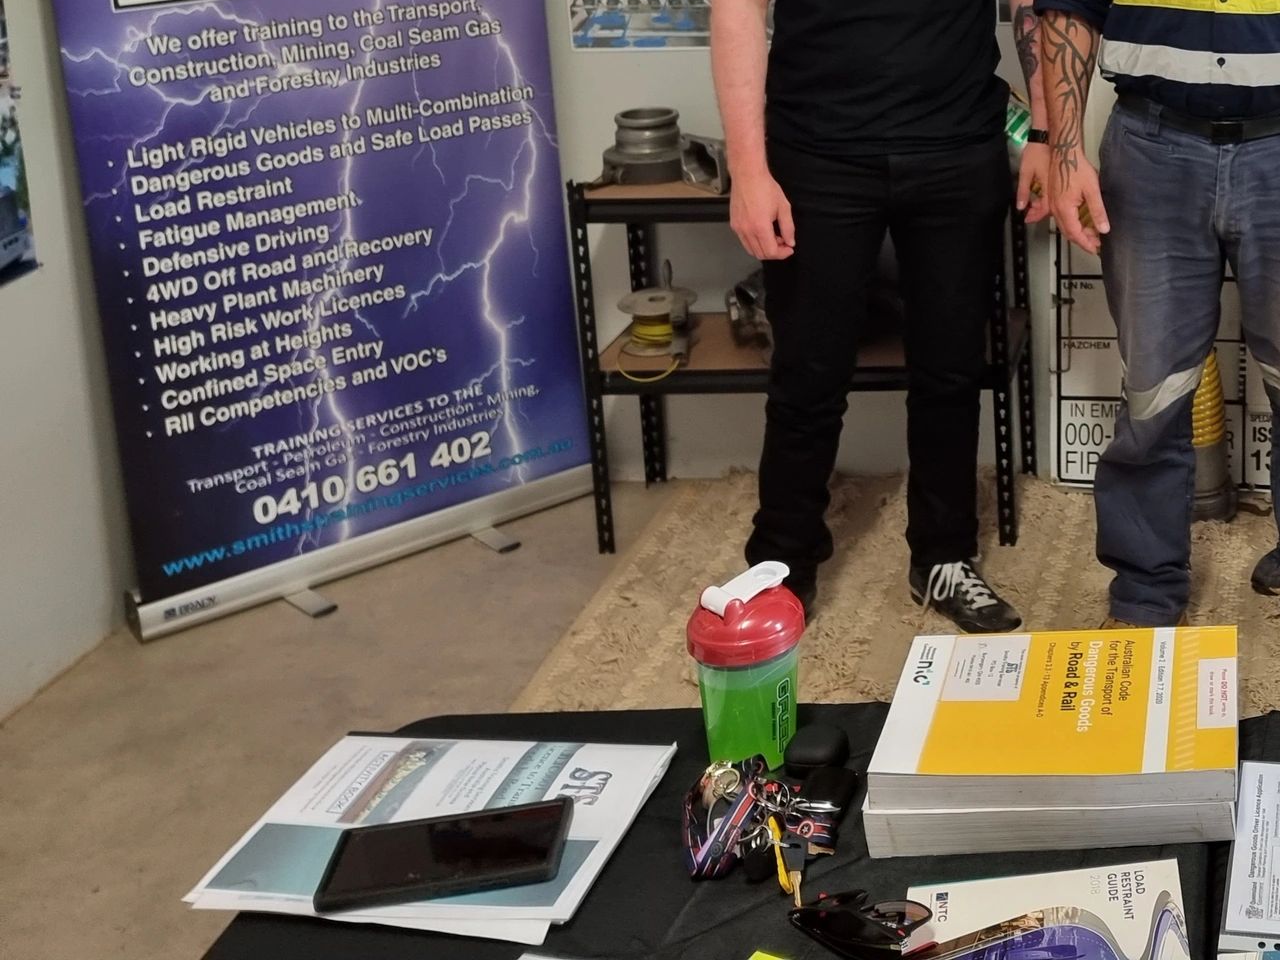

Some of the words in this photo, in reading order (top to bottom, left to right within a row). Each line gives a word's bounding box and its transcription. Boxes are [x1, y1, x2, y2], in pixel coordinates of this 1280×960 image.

[147, 36, 182, 55] We
[188, 29, 237, 52] offer
[243, 18, 323, 43] training
[328, 13, 349, 30] to
[353, 7, 384, 27] the
[128, 142, 186, 168] Light
[192, 133, 246, 159] Rigid
[251, 117, 336, 145] Vehicles
[342, 114, 361, 129] to
[366, 85, 533, 126] Multi-Combination
[135, 197, 190, 222] Load
[197, 179, 293, 210] Restraint
[150, 303, 217, 331] Heavy
[223, 286, 277, 313] Plant
[283, 264, 384, 301] Machinery
[252, 475, 347, 524] 0410
[356, 454, 417, 492] 661
[430, 430, 491, 468] 402
[1070, 641, 1081, 651] by
[1109, 641, 1118, 652] for
[1122, 640, 1135, 676] Australian
[1065, 651, 1083, 679] Road
[1082, 640, 1103, 697] Dangerous
[1108, 654, 1117, 667] the
[1063, 679, 1077, 690] &
[1103, 667, 1116, 705] Transport
[1118, 678, 1127, 701] Code
[1059, 690, 1077, 711] Rail
[1100, 707, 1110, 717] of
[1076, 698, 1096, 733] Goods
[1250, 835, 1258, 850] Goods
[1107, 873, 1119, 902] GUIDE
[1120, 871, 1134, 920] RESTRAINT
[1134, 870, 1146, 895] LOAD
[937, 900, 948, 922] NTC
